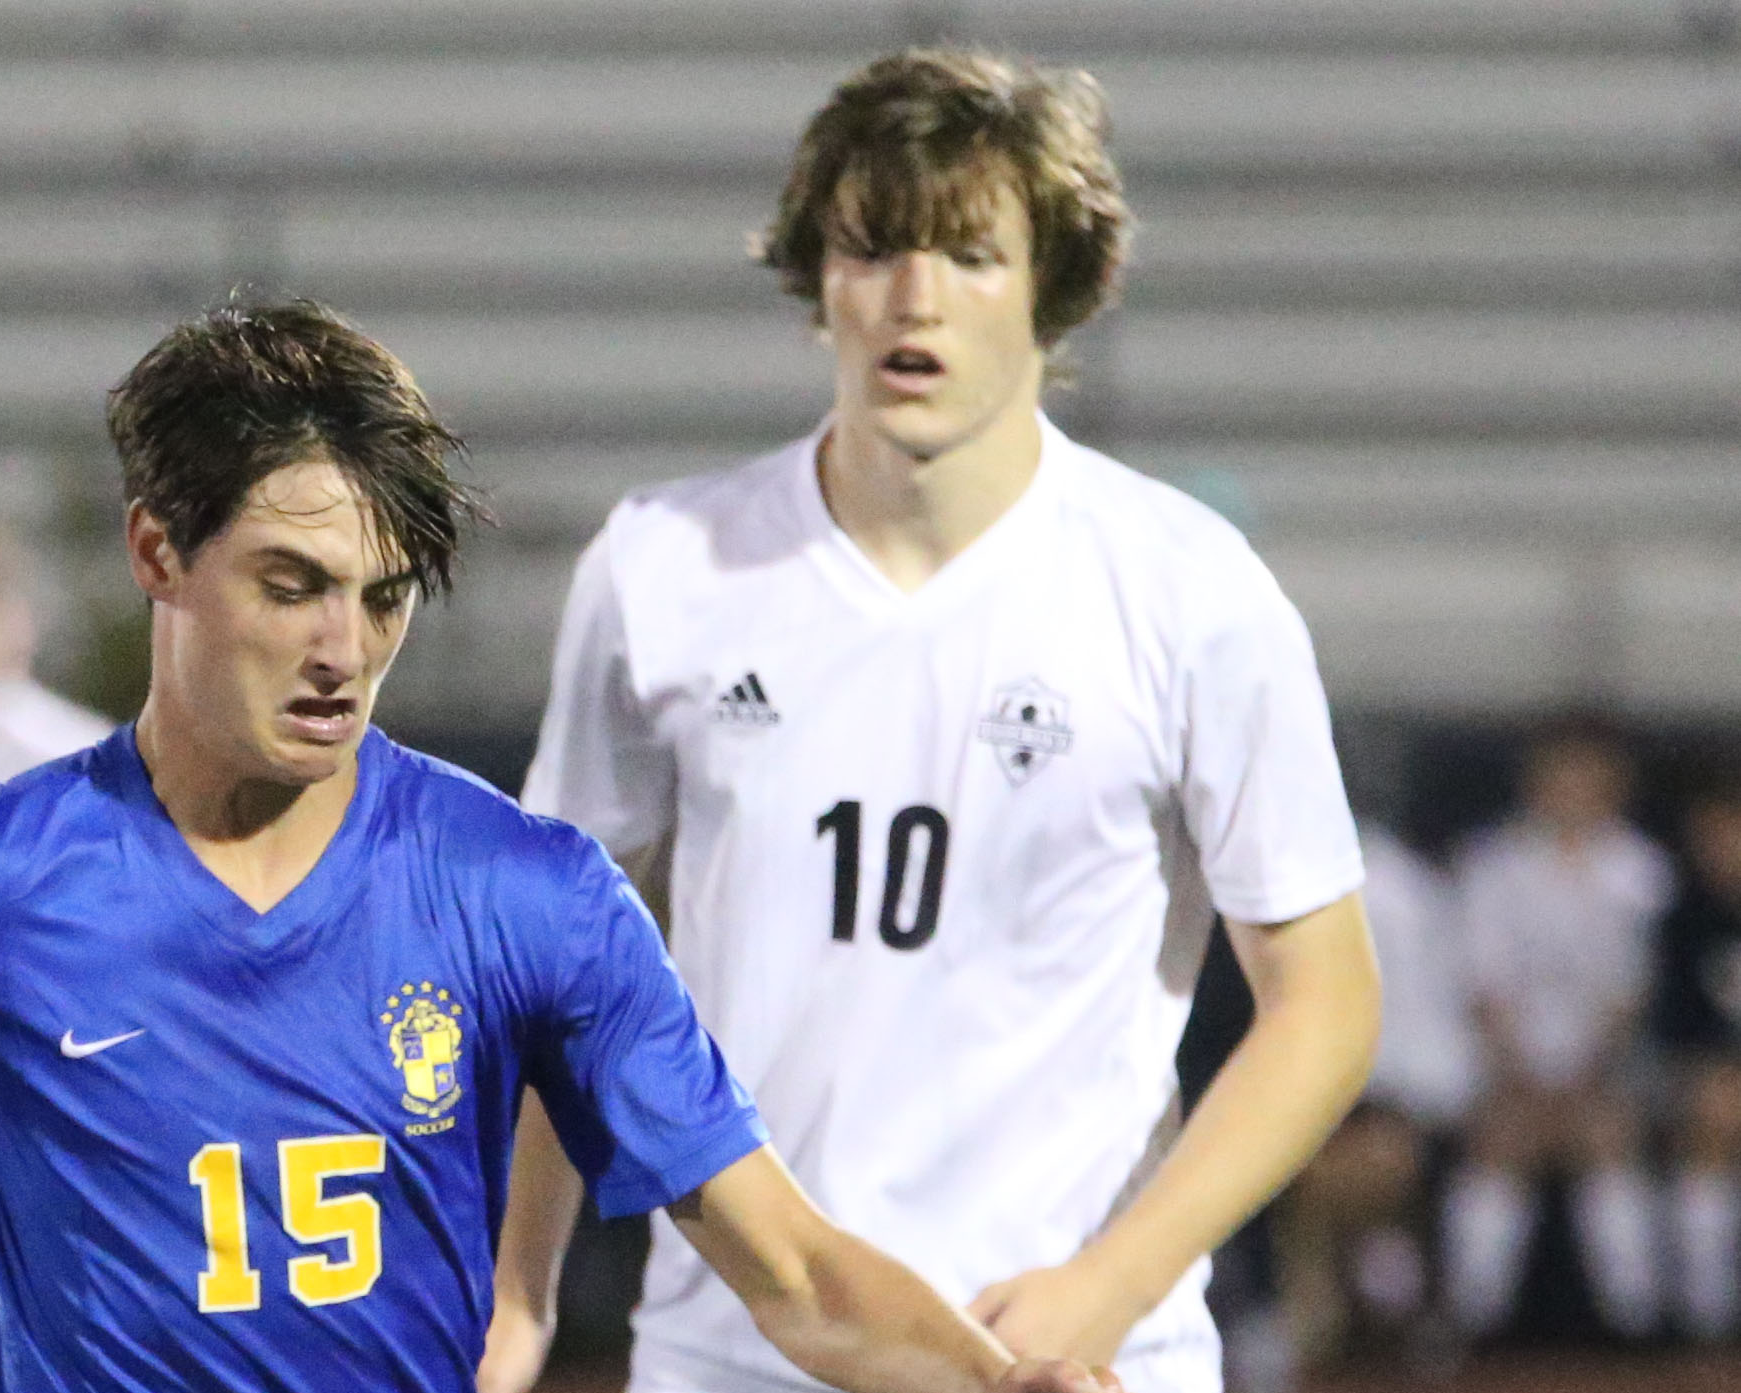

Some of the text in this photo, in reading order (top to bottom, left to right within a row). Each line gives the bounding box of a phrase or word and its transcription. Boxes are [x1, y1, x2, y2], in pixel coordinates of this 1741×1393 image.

[815, 800, 950, 951] 10
[405, 1116, 456, 1137] SOCCER
[189, 1133, 387, 1314] 15
